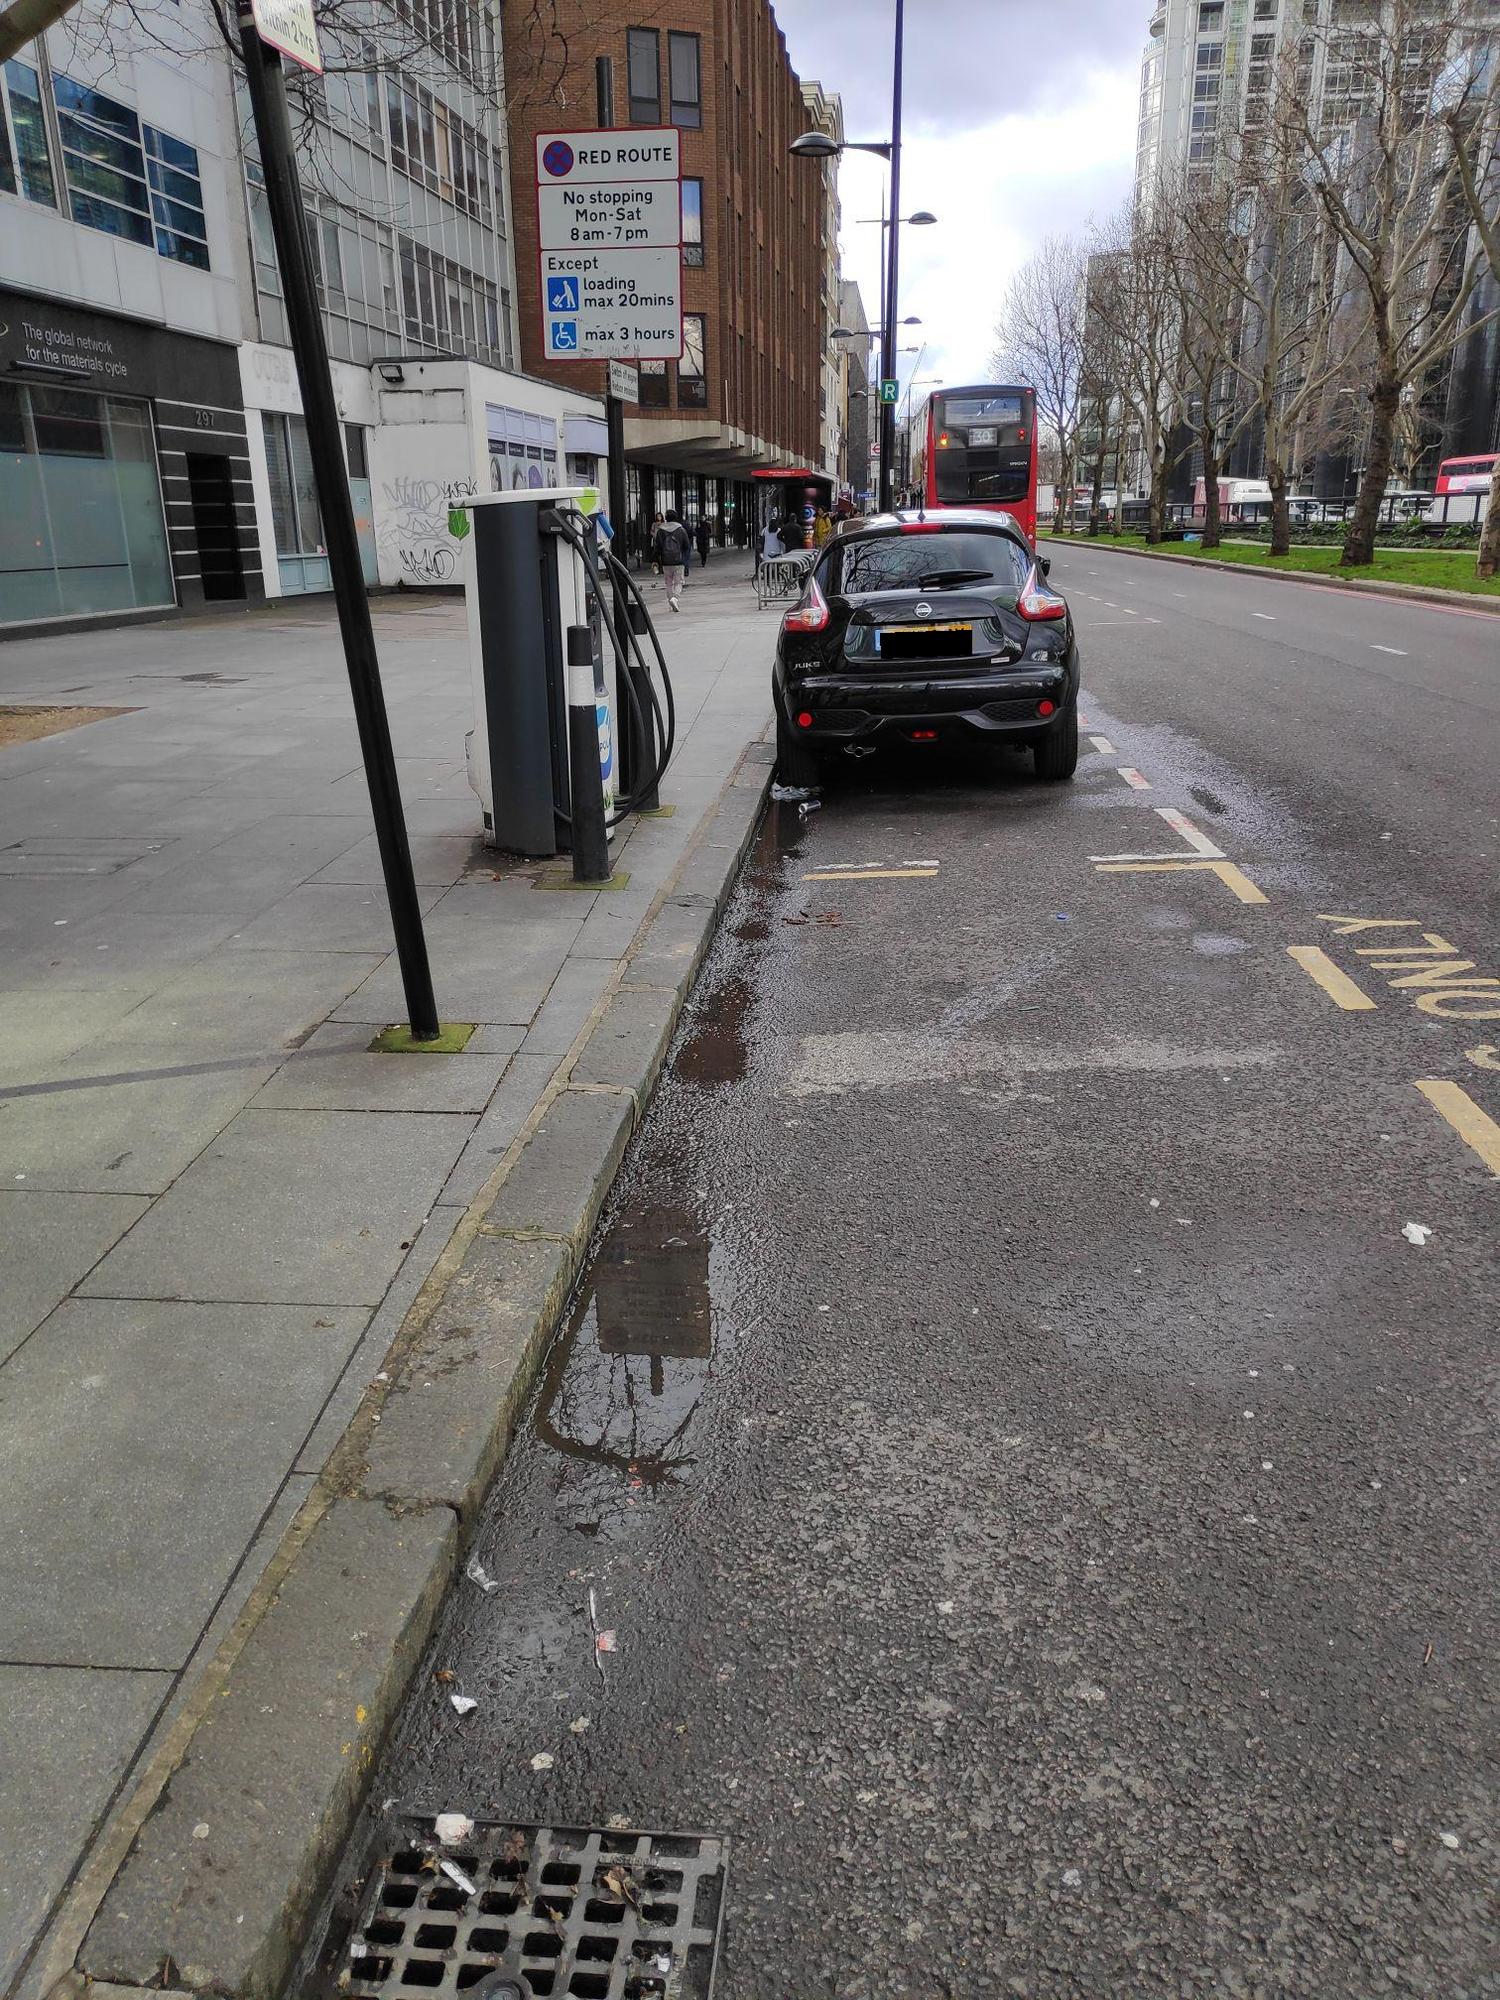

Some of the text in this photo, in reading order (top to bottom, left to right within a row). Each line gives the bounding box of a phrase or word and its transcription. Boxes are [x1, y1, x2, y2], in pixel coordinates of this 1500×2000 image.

[578, 147, 673, 165] RED ROUTE
[563, 190, 653, 205] No stopping
[575, 208, 642, 222] Mon-Sat
[548, 257, 599, 271] Except
[583, 278, 636, 290] loading
[584, 293, 675, 307] max 20mins
[22, 322, 113, 355] The global network
[585, 326, 675, 341] max 3 hours
[26, 344, 128, 377] for the materials cycle
[884, 383, 896, 399] R
[195, 411, 214, 426] 297
[1316, 914, 1500, 1020] ONLY
